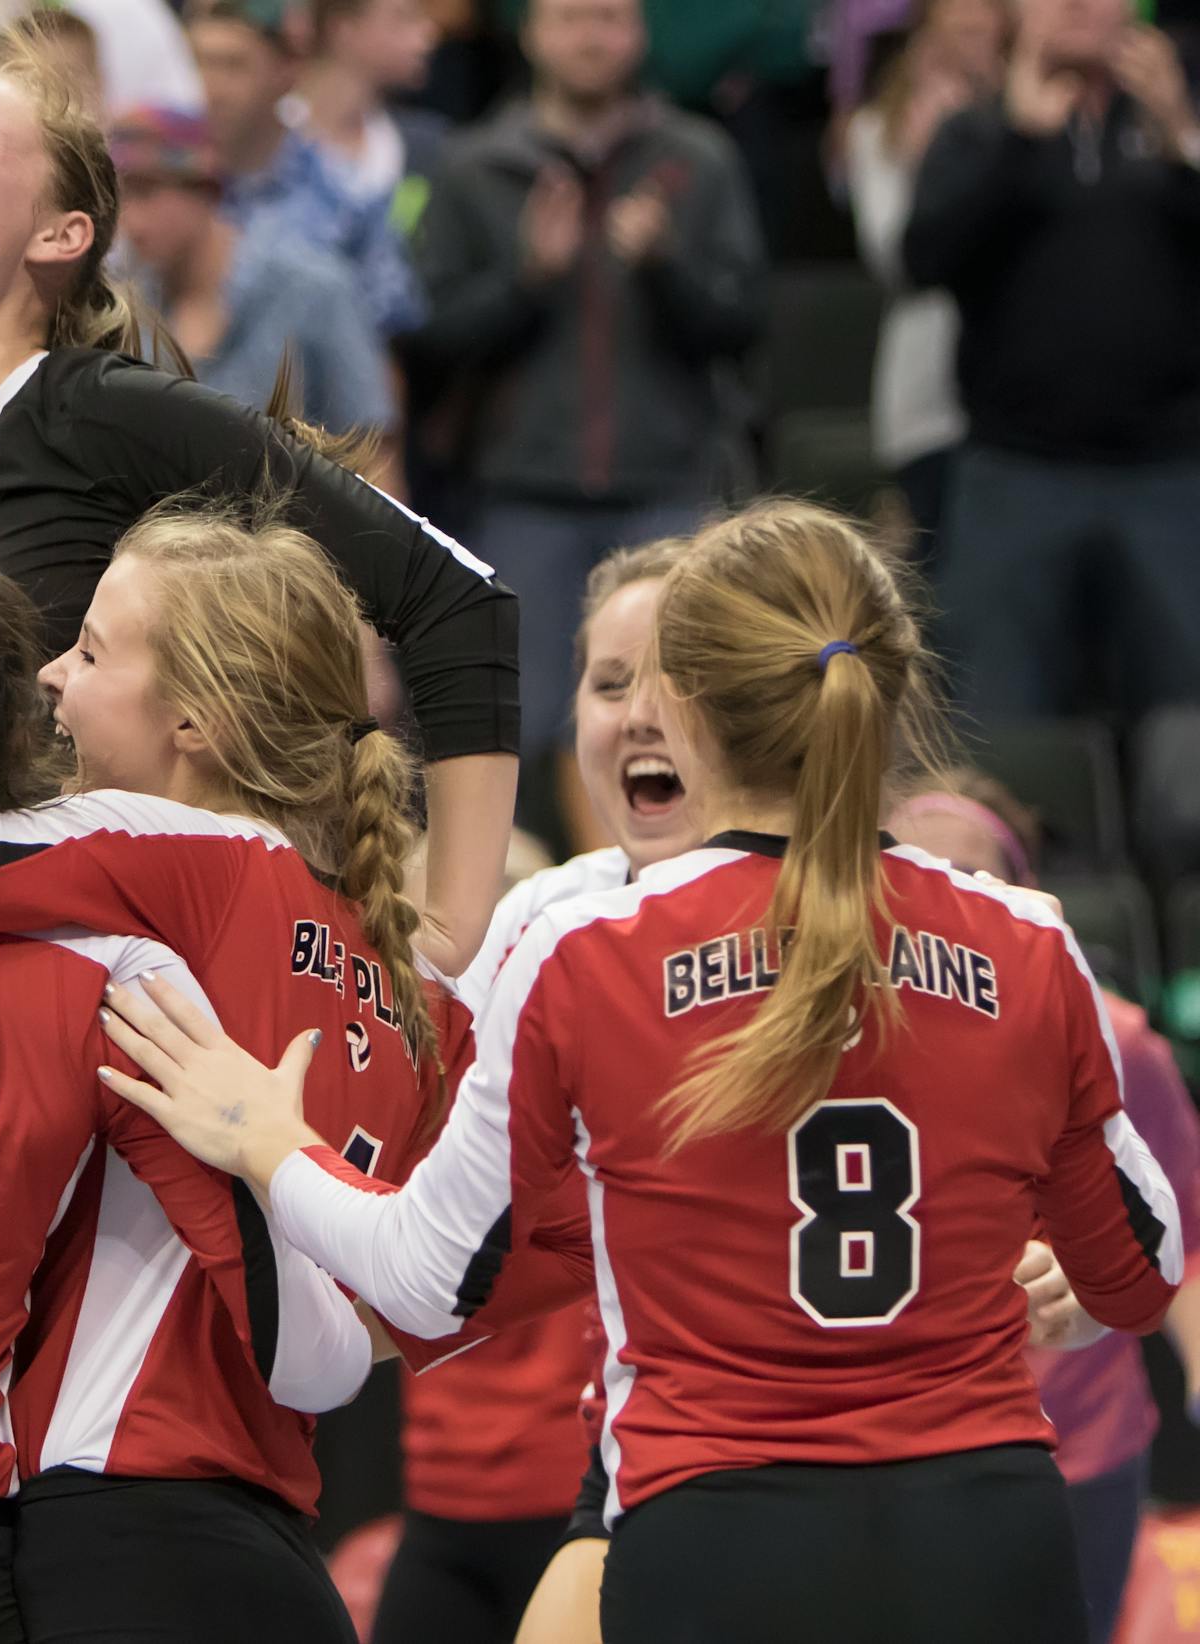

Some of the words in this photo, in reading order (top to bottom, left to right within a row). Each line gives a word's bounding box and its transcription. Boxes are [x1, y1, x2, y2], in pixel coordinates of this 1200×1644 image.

[663, 926, 798, 1018] BELL
[862, 925, 999, 1020] AINE
[787, 1097, 921, 1327] 8
